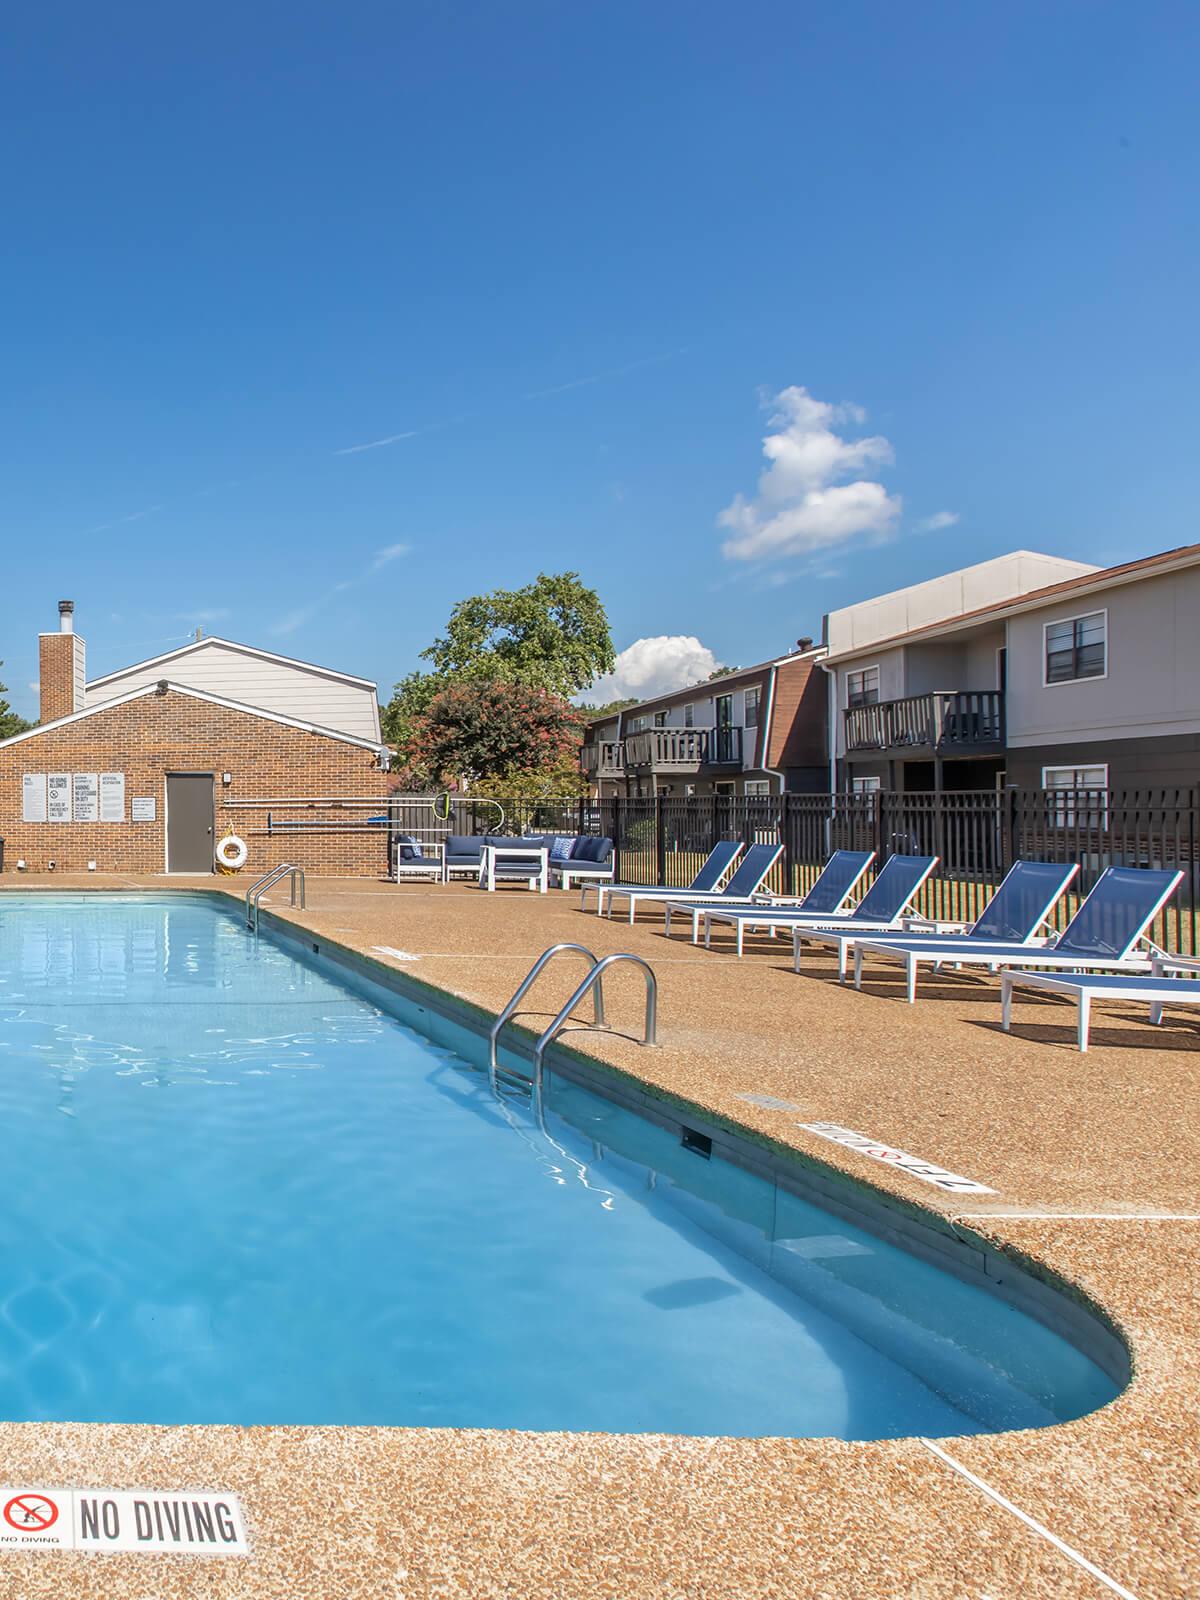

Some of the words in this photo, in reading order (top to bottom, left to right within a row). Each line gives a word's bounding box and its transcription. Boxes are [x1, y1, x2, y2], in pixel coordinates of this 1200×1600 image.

[80, 1498, 120, 1540] NO
[134, 1500, 238, 1543] DIVING
[21, 1536, 60, 1544] DIVING
